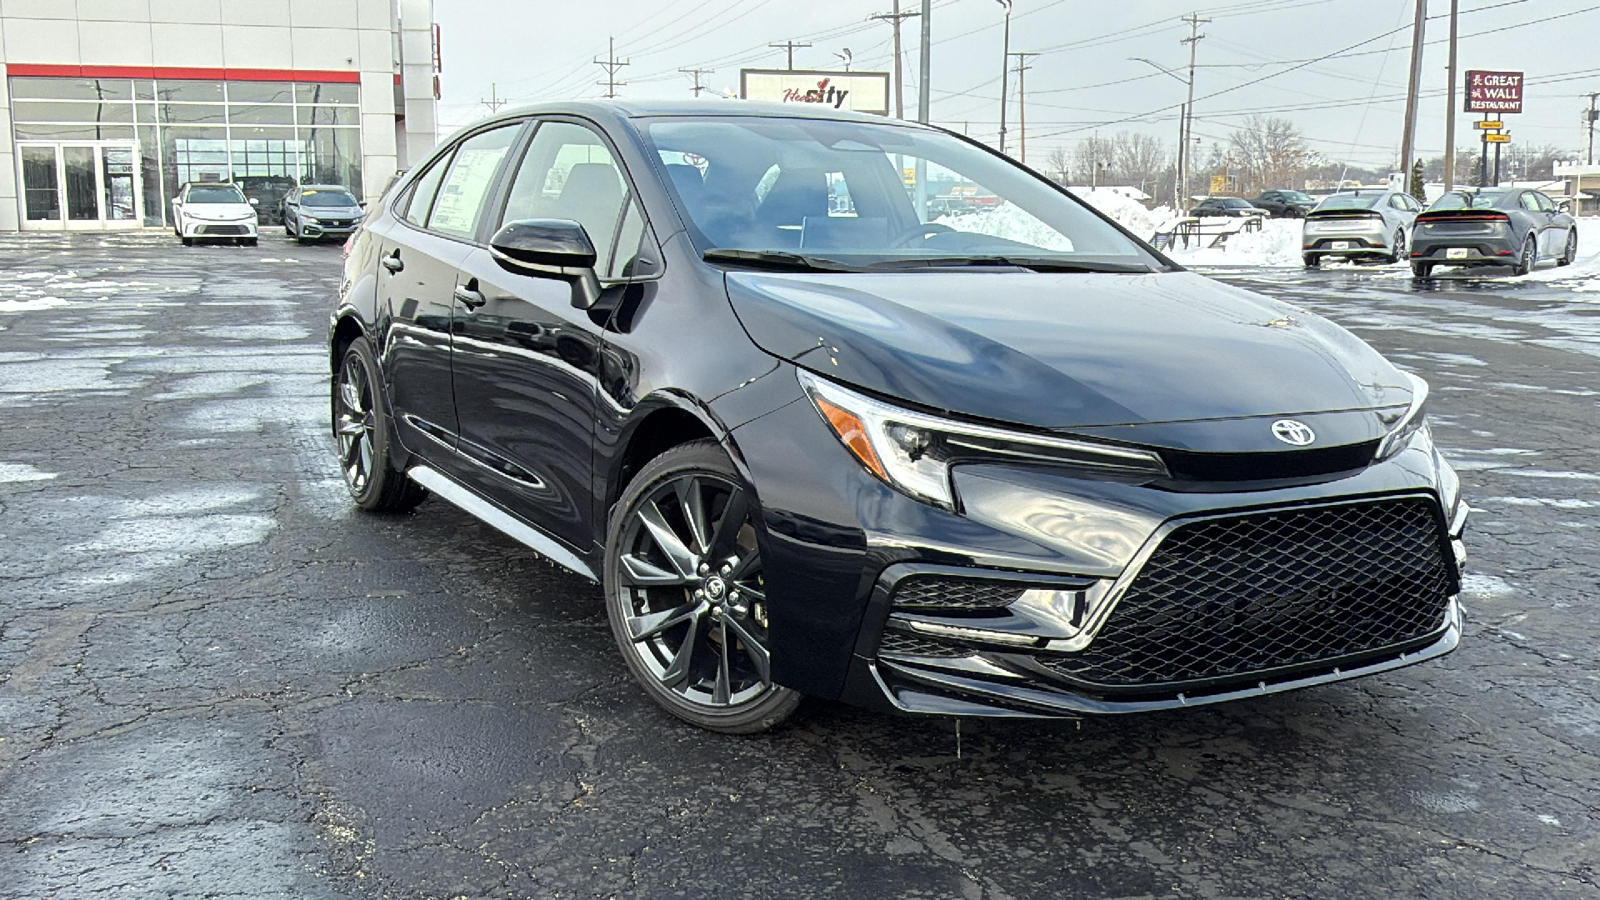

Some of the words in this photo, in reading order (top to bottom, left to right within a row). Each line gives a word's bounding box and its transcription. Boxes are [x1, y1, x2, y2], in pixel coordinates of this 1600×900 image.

[1484, 75, 1520, 86] GREAT
[1484, 88, 1518, 99] WALL
[1471, 101, 1520, 109] RESTAURANT
